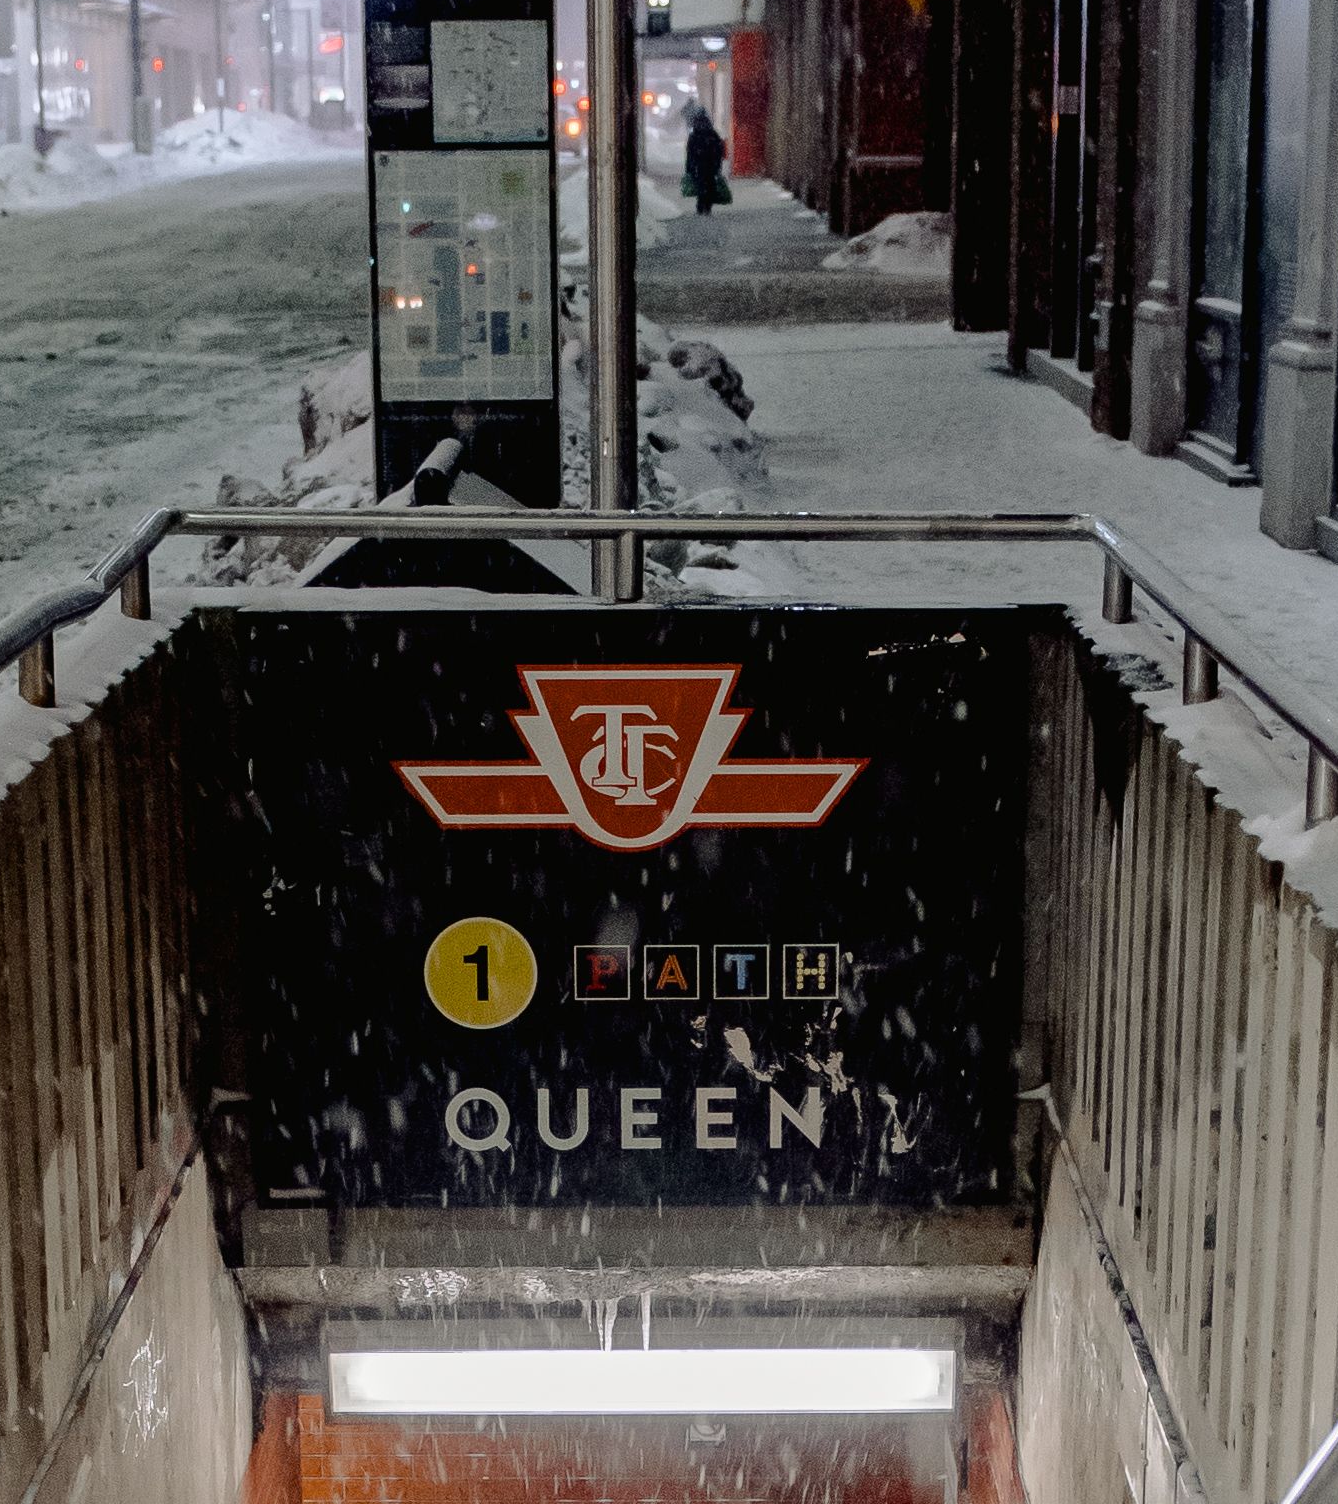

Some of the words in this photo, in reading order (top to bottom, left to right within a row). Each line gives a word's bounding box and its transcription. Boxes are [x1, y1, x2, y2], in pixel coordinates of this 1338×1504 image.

[570, 704, 680, 807] TTC
[462, 944, 490, 1002] 1
[584, 950, 829, 994] PATH
[444, 1086, 823, 1154] QUEEN
